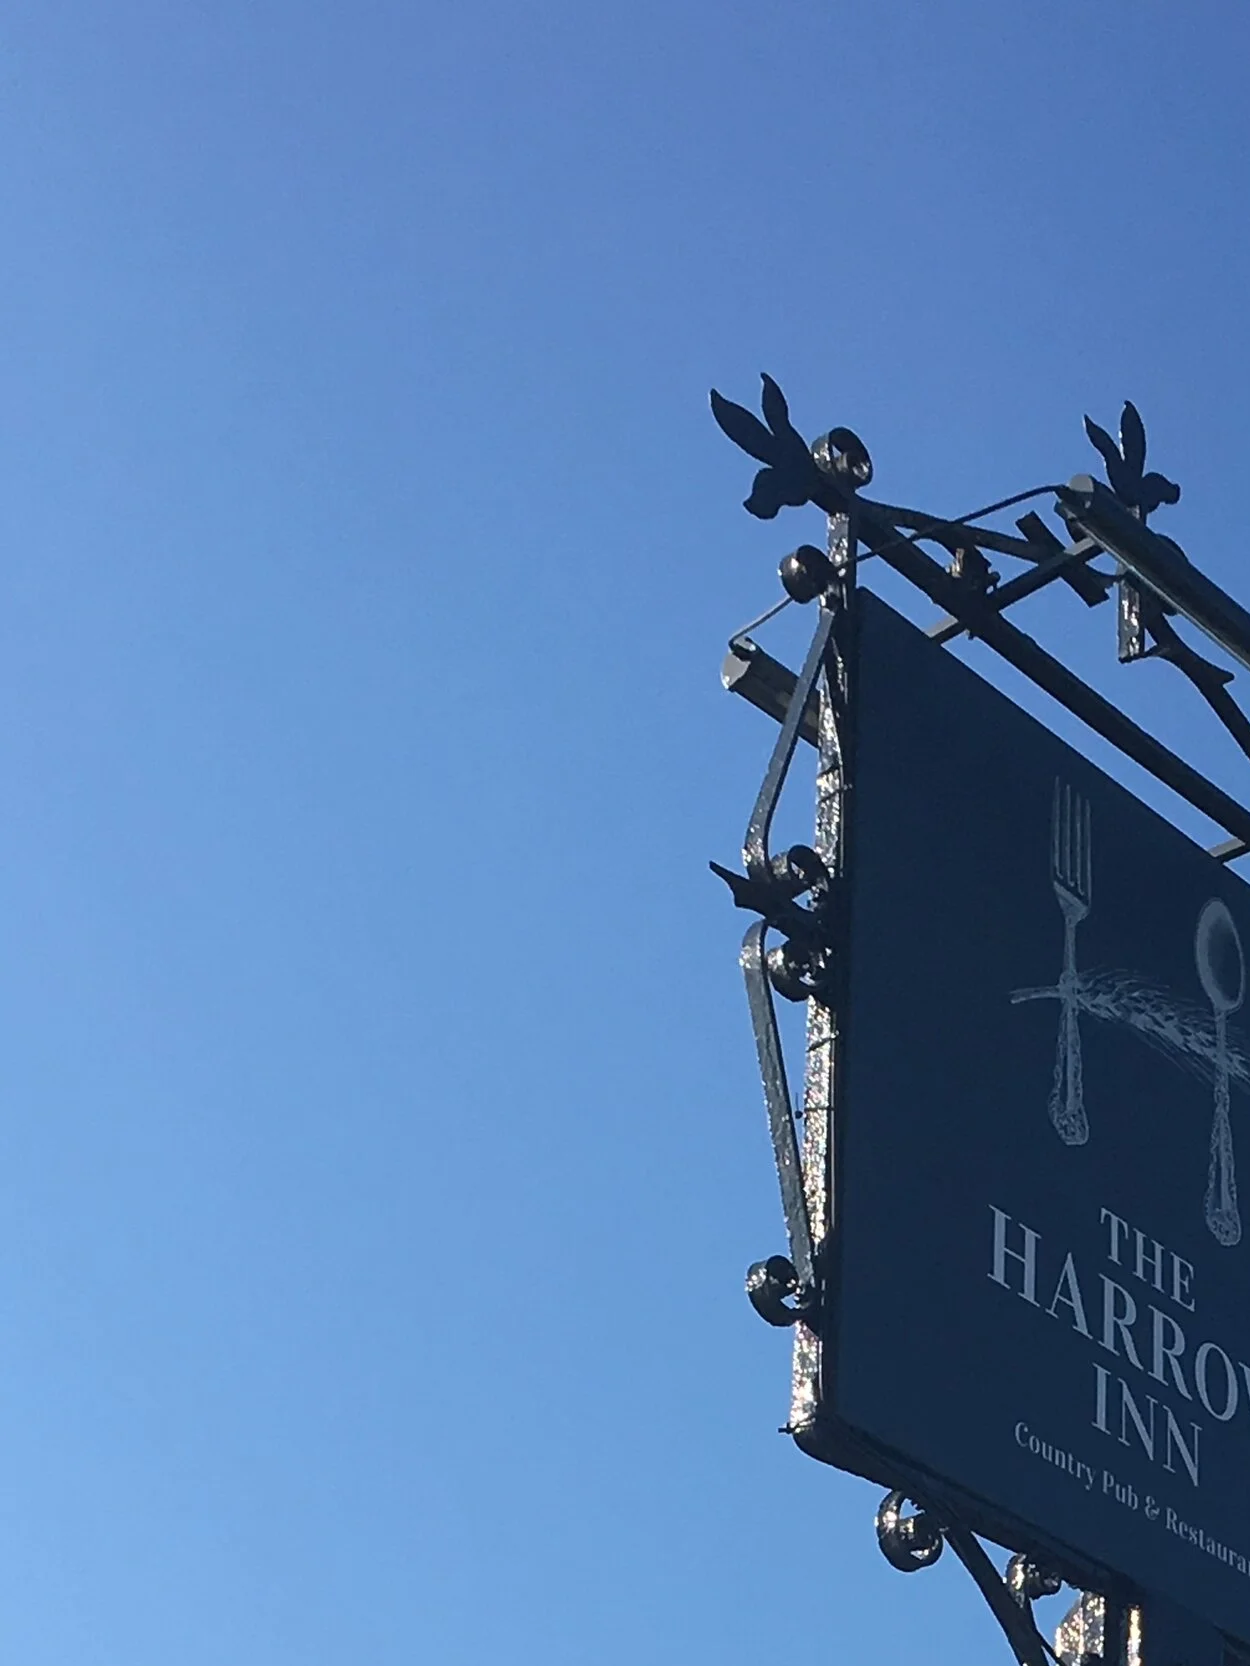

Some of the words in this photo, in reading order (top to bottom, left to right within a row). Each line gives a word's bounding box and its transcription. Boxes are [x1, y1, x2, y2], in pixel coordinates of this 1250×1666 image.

[1100, 1208, 1197, 1312] THE
[1014, 1421, 1096, 1491] Country
[1102, 1469, 1139, 1511] Pub
[1144, 1495, 1161, 1521] &
[1092, 1362, 1202, 1487] INN
